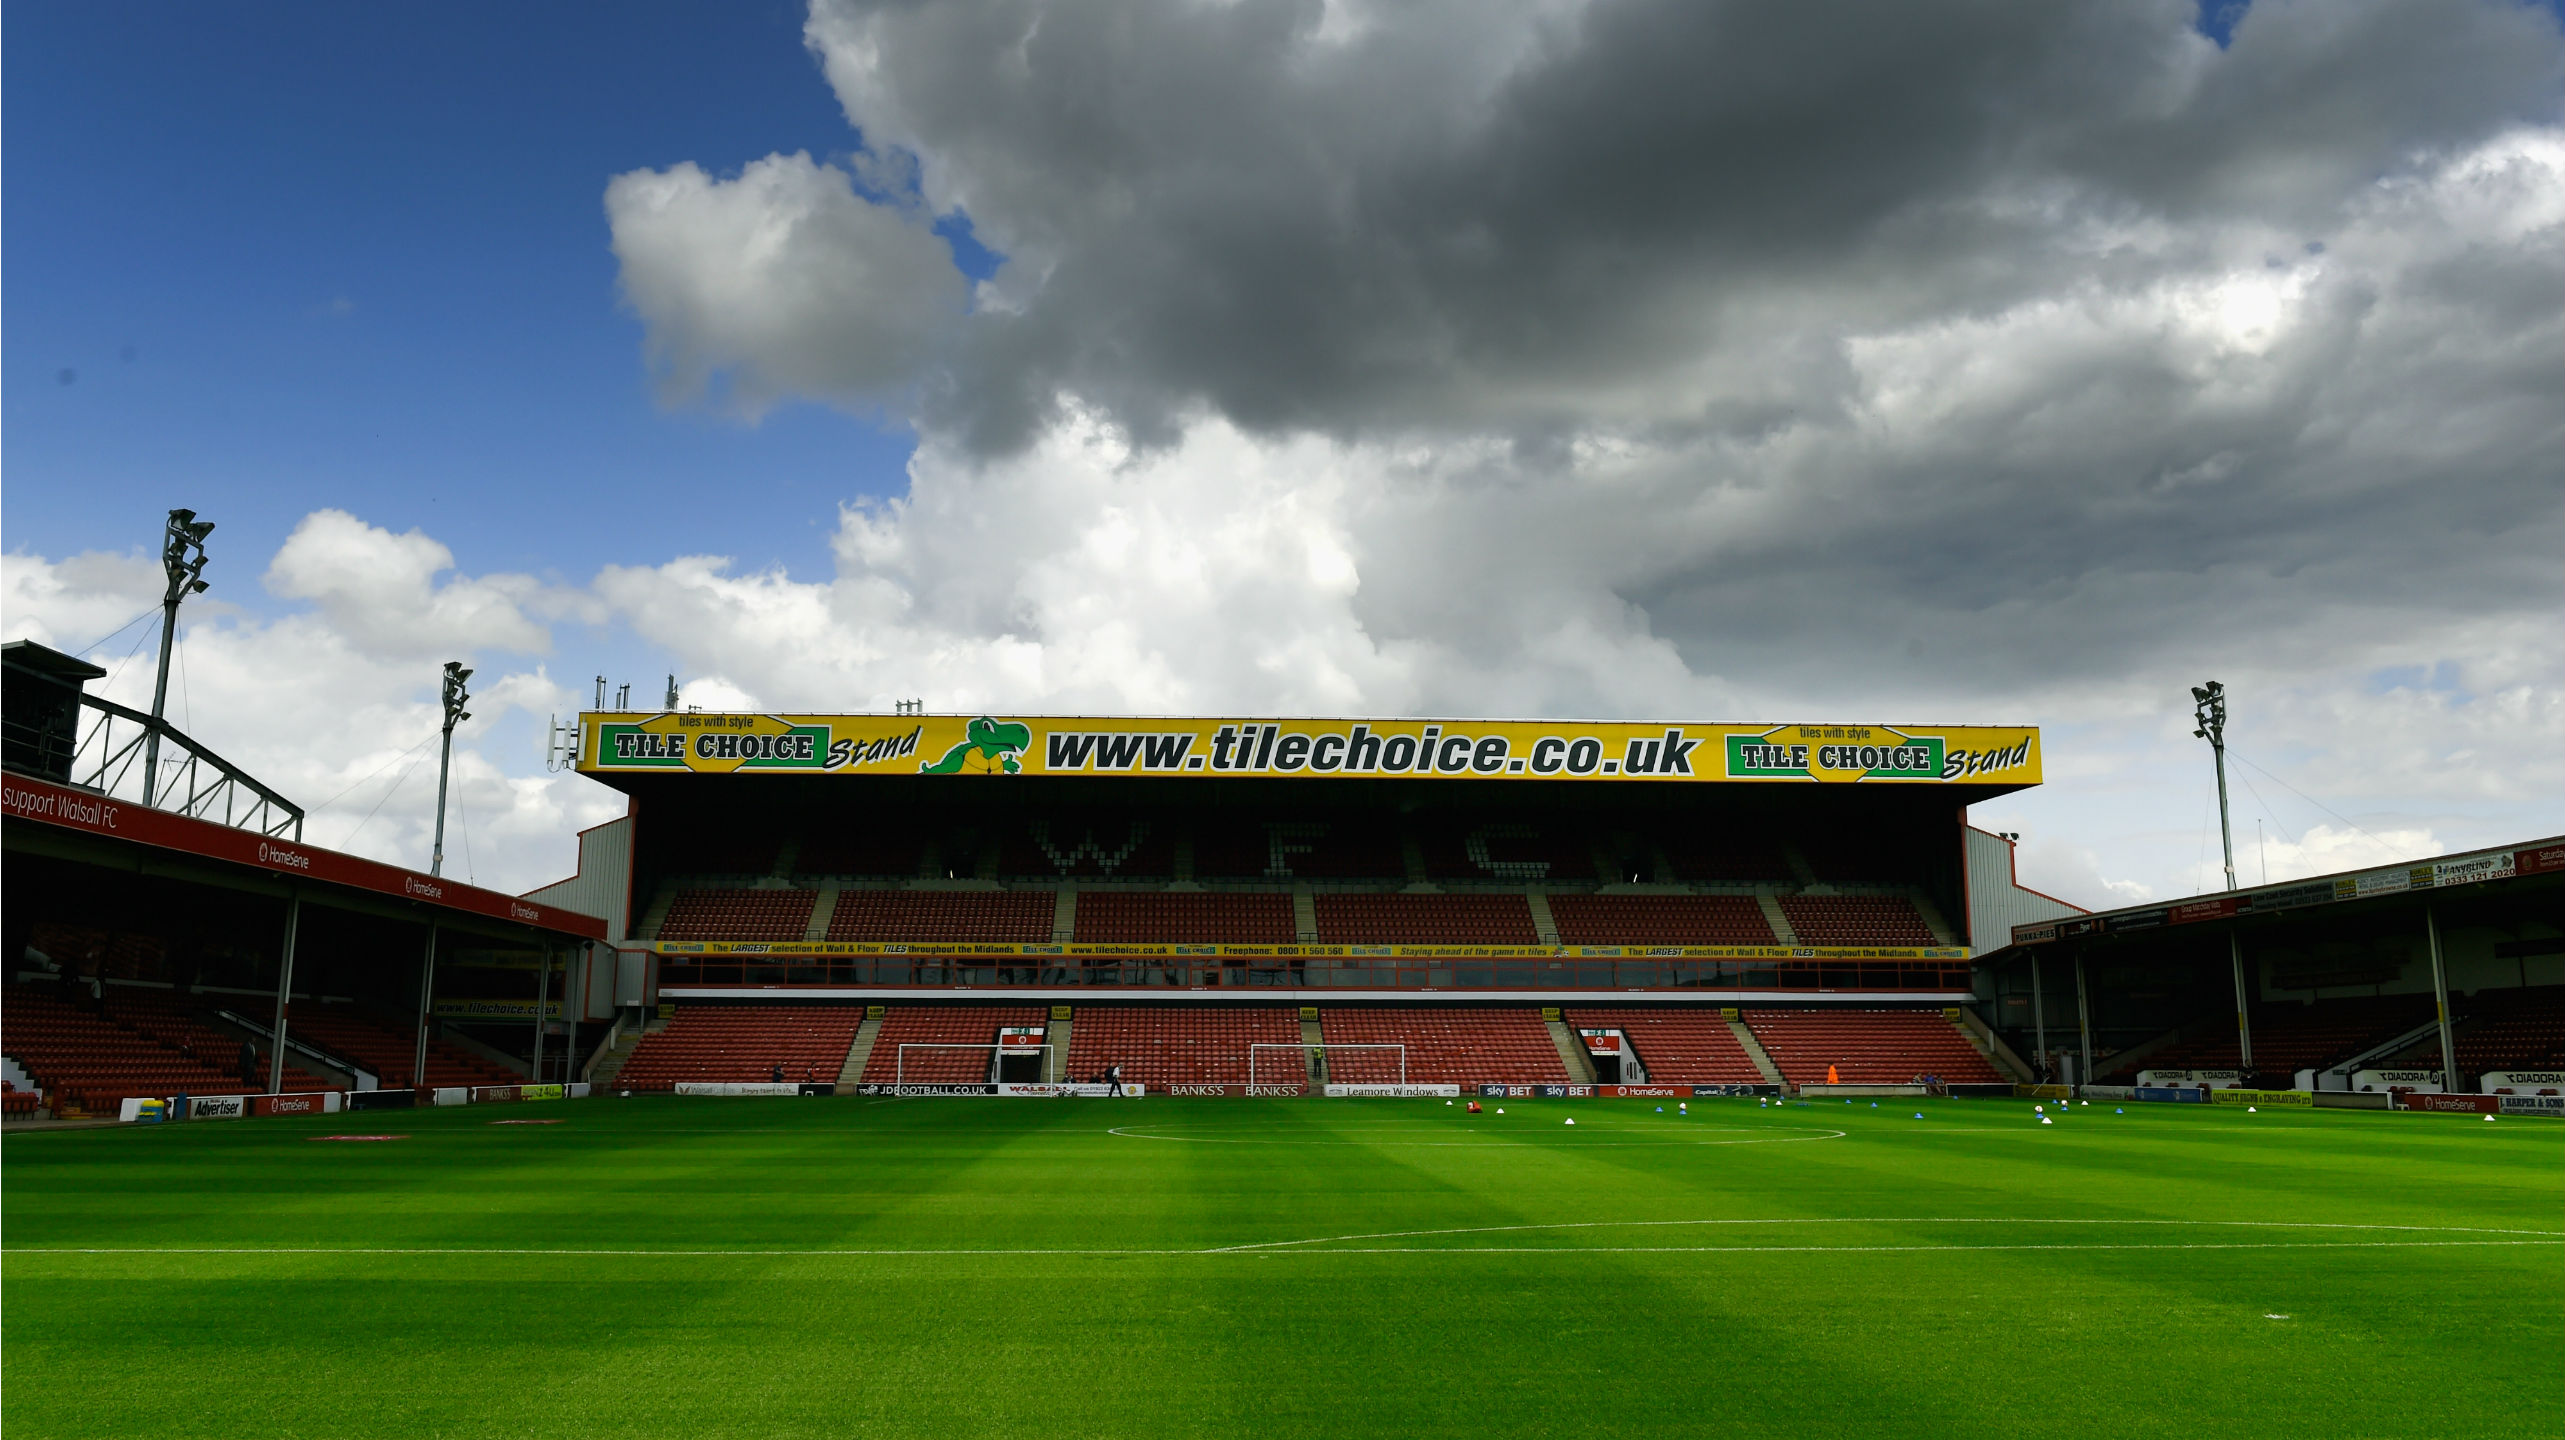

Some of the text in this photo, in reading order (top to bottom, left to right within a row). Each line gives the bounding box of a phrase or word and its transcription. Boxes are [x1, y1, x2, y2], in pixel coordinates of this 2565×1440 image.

[678, 715, 754, 730] tiles with style
[1800, 726, 1871, 740] tiles with style
[614, 732, 816, 762] TILE CHOICE
[820, 725, 922, 772] Stand
[1046, 723, 1702, 776] www.tilechoice.co.uk
[1741, 744, 1931, 770] TILE CHOICE
[1939, 735, 2033, 781] Stand
[2, 787, 118, 829] support Walsall FC
[269, 846, 309, 869] HomeServe
[2538, 848, 2565, 861] Saturda
[2445, 875, 2468, 885] 0333
[2471, 872, 2488, 881] 121
[2491, 868, 2515, 878] 2020
[413, 881, 442, 899] HomeServe
[516, 905, 539, 921] HomeServe
[713, 944, 728, 952] The
[731, 944, 771, 953] LARGEST
[771, 944, 813, 953] selection
[815, 944, 825, 952] of
[857, 945, 880, 953] Floor
[884, 945, 907, 954] TILES
[908, 945, 955, 954] throughout
[958, 945, 972, 953] the
[975, 945, 1014, 953] Midlands
[1071, 946, 1168, 954] www.tilechoice.co.uk
[1224, 947, 1272, 956] Freephone:
[1278, 947, 1299, 955] 0800
[1400, 948, 1433, 957] Staying
[1434, 948, 1462, 956] ahead
[1464, 948, 1474, 956] of
[1475, 948, 1489, 956] the
[1492, 949, 1514, 957] game
[1628, 948, 1643, 956] The
[1645, 948, 1684, 957] LARGEST
[1685, 948, 1724, 956] selection
[1726, 948, 1736, 956] of
[1791, 949, 1814, 957] TILES
[1815, 949, 1861, 958] throughout
[1863, 949, 1877, 957] the
[1879, 949, 1917, 957] Midlands
[437, 1002, 558, 1016] www.tilechoice.couk
[2388, 1072, 2426, 1081] DIADORA
[2516, 1073, 2563, 1084] DIADORA
[1171, 1085, 1225, 1097] BANKS'S
[1245, 1085, 1299, 1097] BANKS'S
[1347, 1086, 1439, 1097] Leamore Windows
[1486, 1086, 1532, 1097] sky BET
[1546, 1086, 1591, 1097] sky BET
[1629, 1087, 1674, 1096] HomeServe
[195, 1100, 239, 1117] Advertiser
[279, 1099, 310, 1112] HomeServe
[2435, 1098, 2476, 1111] HomeServe
